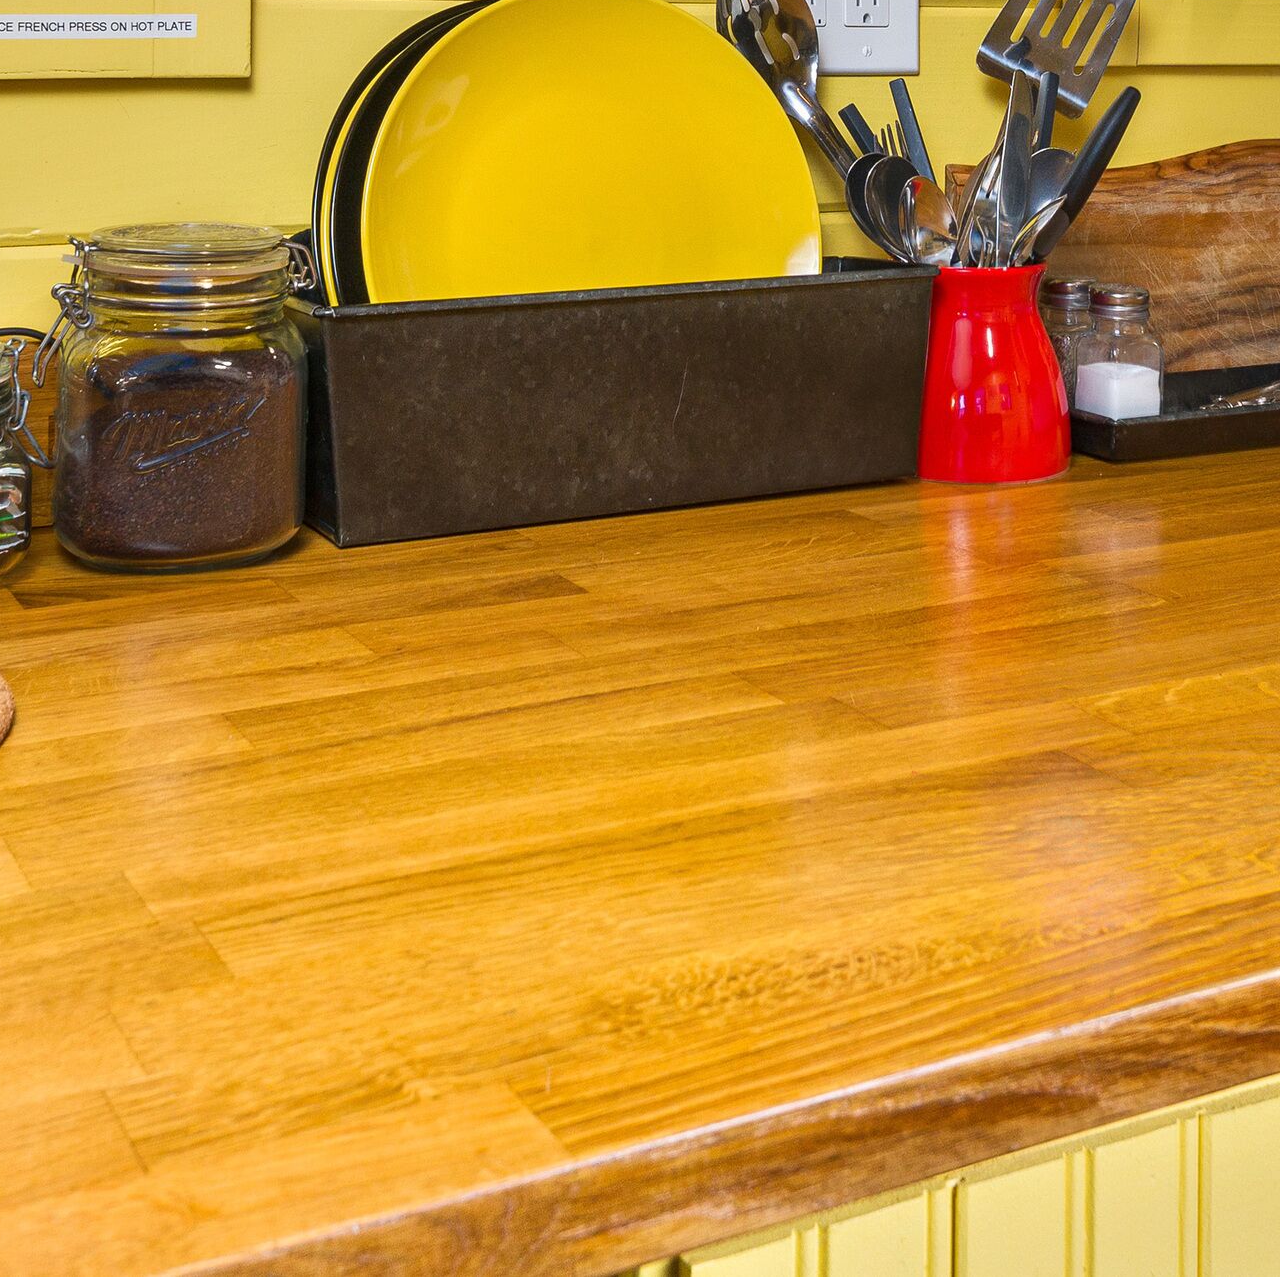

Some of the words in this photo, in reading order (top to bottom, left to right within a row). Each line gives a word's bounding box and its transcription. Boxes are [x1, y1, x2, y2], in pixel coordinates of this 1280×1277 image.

[18, 21, 65, 32] FRENCH
[69, 21, 107, 32] PRESS
[110, 21, 127, 31] ON
[131, 21, 154, 31] HOT
[157, 21, 192, 31] PLATE
